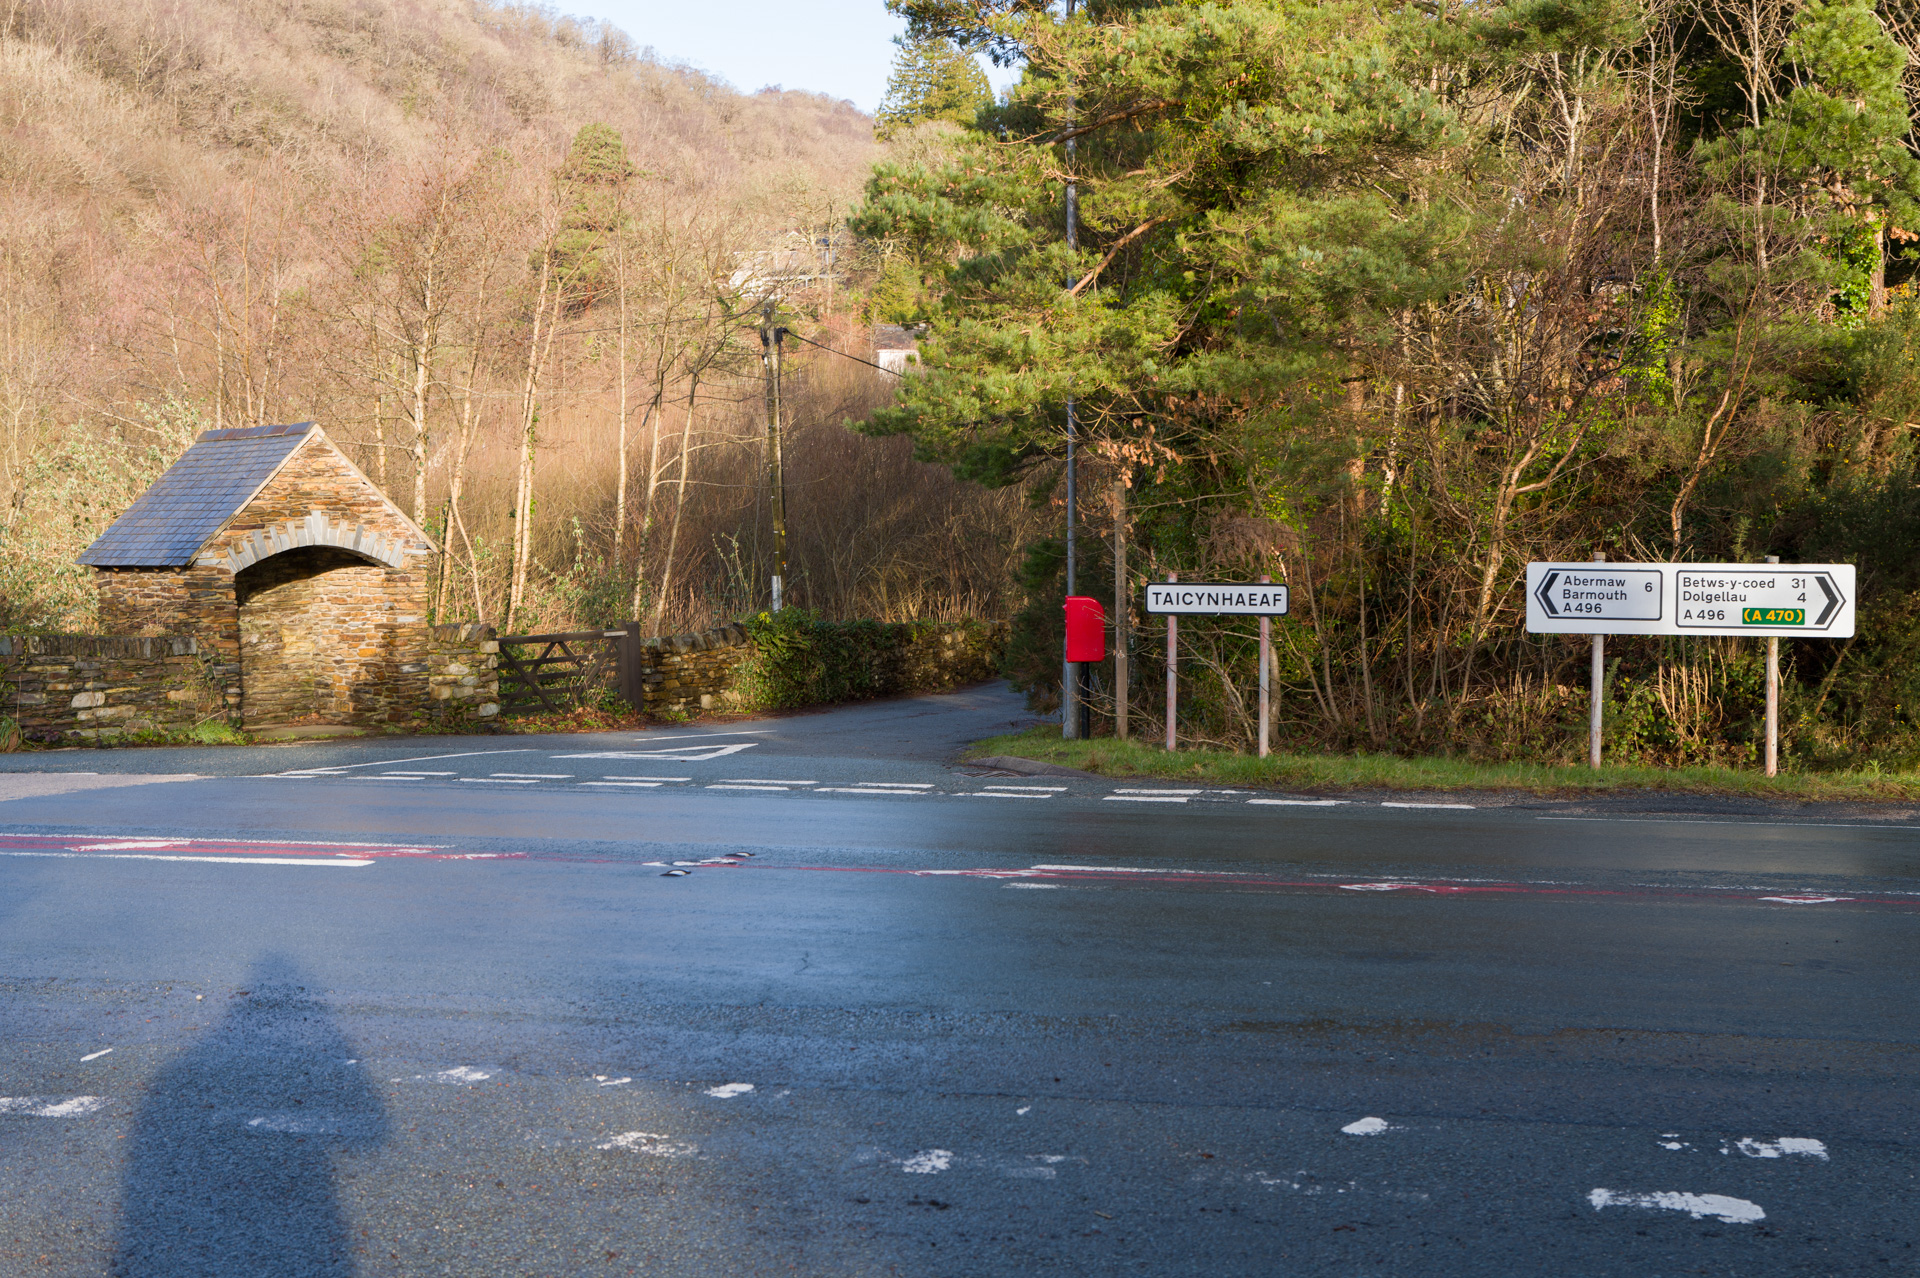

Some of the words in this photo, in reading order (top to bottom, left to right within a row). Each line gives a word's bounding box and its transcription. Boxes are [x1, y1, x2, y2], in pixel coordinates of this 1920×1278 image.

[1563, 575, 1626, 587] Abermaw
[1644, 582, 1653, 593] 6
[1683, 577, 1775, 590] Betws-y-coed
[1791, 578, 1806, 589] 31
[1152, 592, 1282, 607] TAICYNHAEAF
[1562, 588, 1628, 601] Barmouth
[1683, 591, 1747, 604] Dolgellau
[1796, 592, 1807, 603] 4
